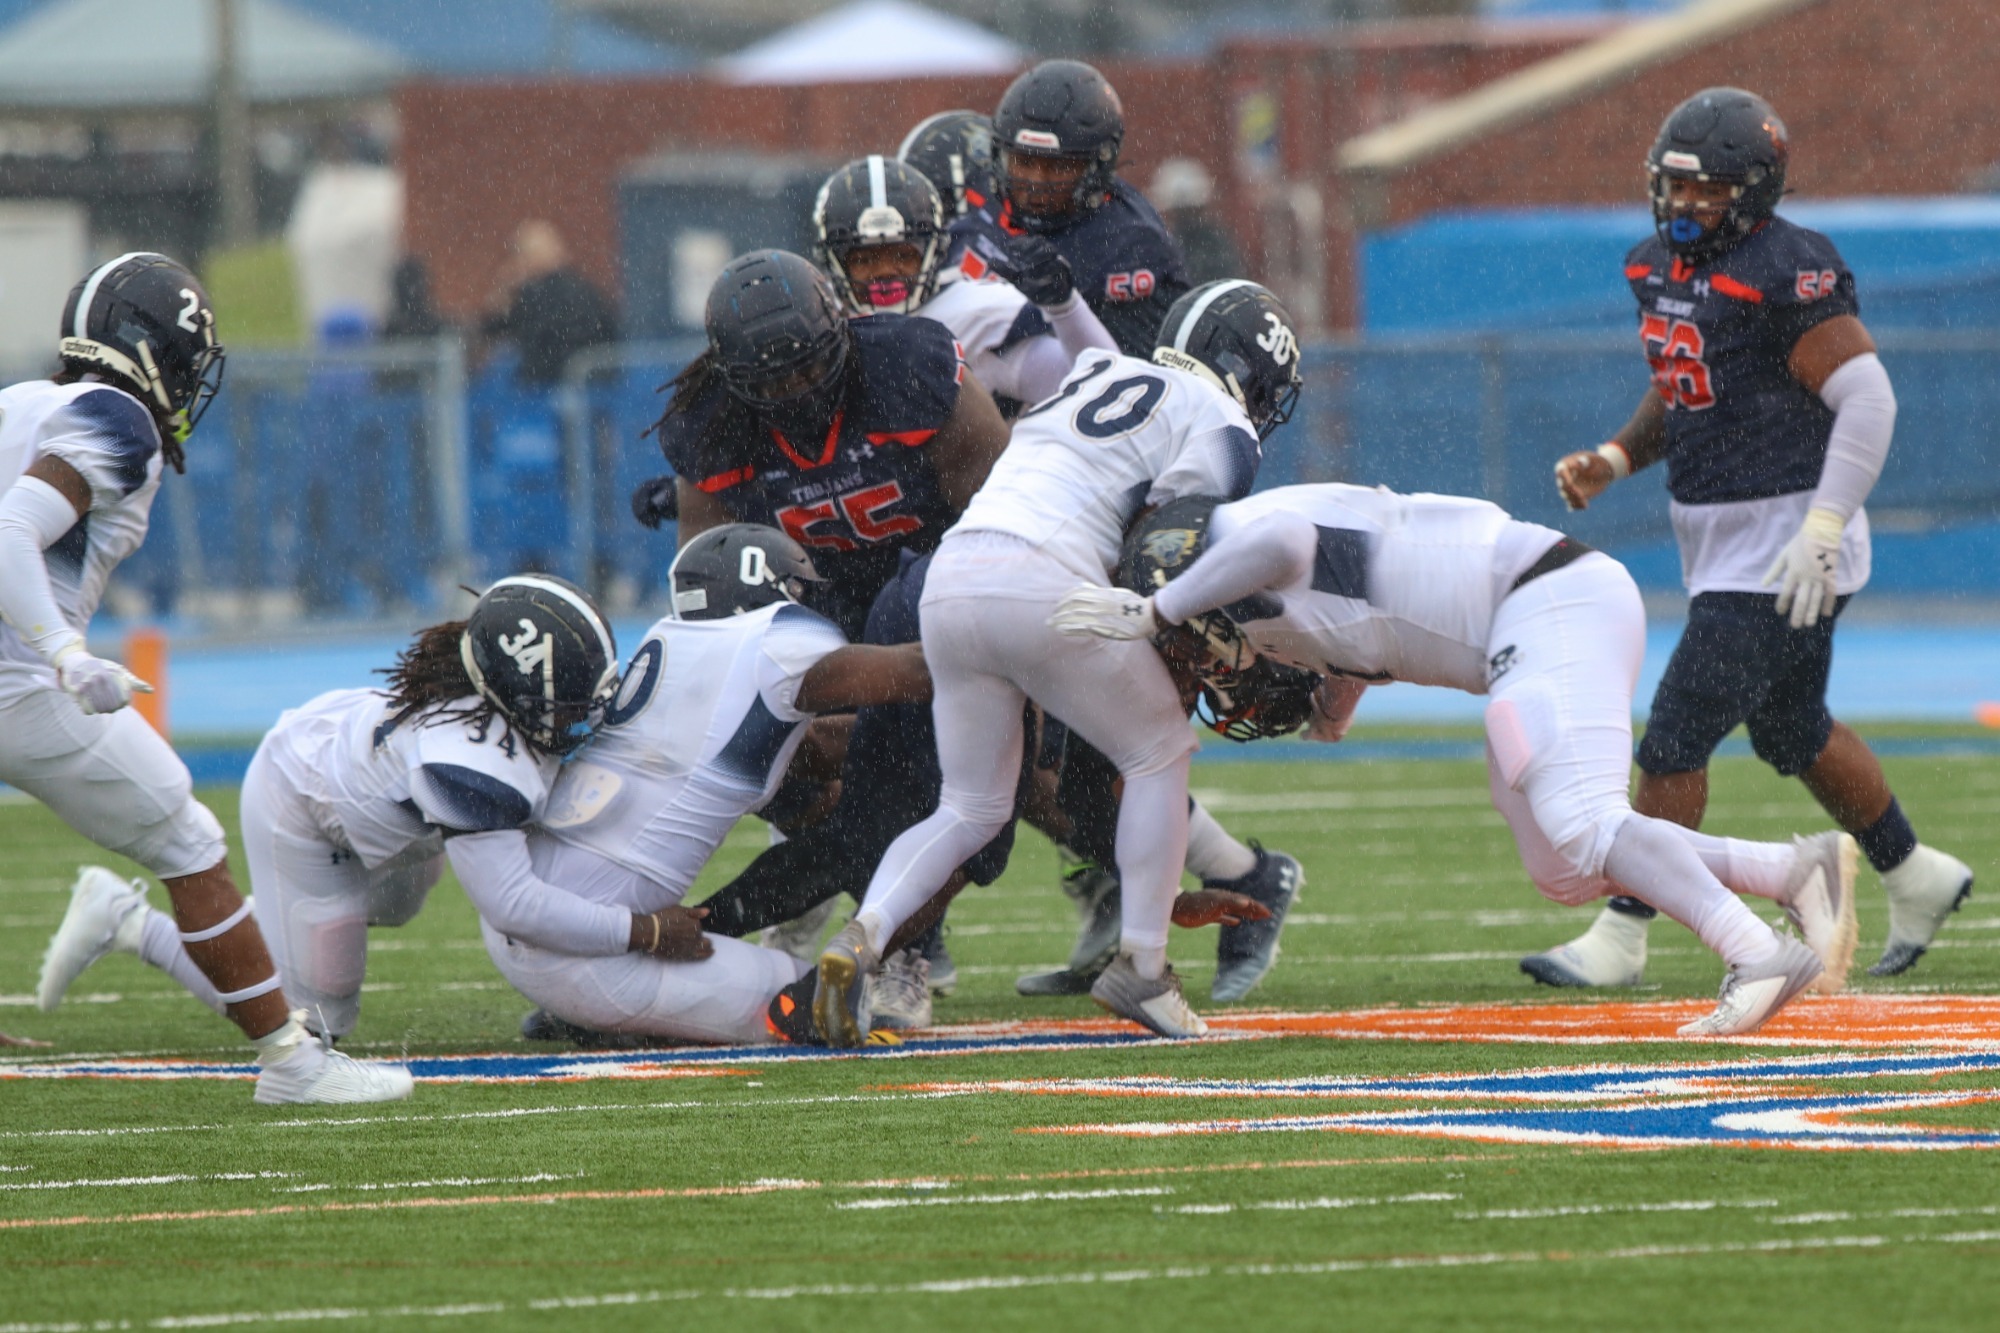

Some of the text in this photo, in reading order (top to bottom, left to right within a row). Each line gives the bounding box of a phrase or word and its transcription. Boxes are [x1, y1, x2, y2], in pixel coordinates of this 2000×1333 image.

[1795, 269, 1837, 302] 56
[1160, 351, 1197, 371] schutt
[1256, 312, 1292, 366] 30
[1640, 312, 1716, 411] 56
[791, 472, 864, 503] TROJANS
[775, 480, 924, 552] 55
[740, 546, 766, 586] 0
[498, 617, 546, 675] 34
[467, 714, 518, 759] 34
